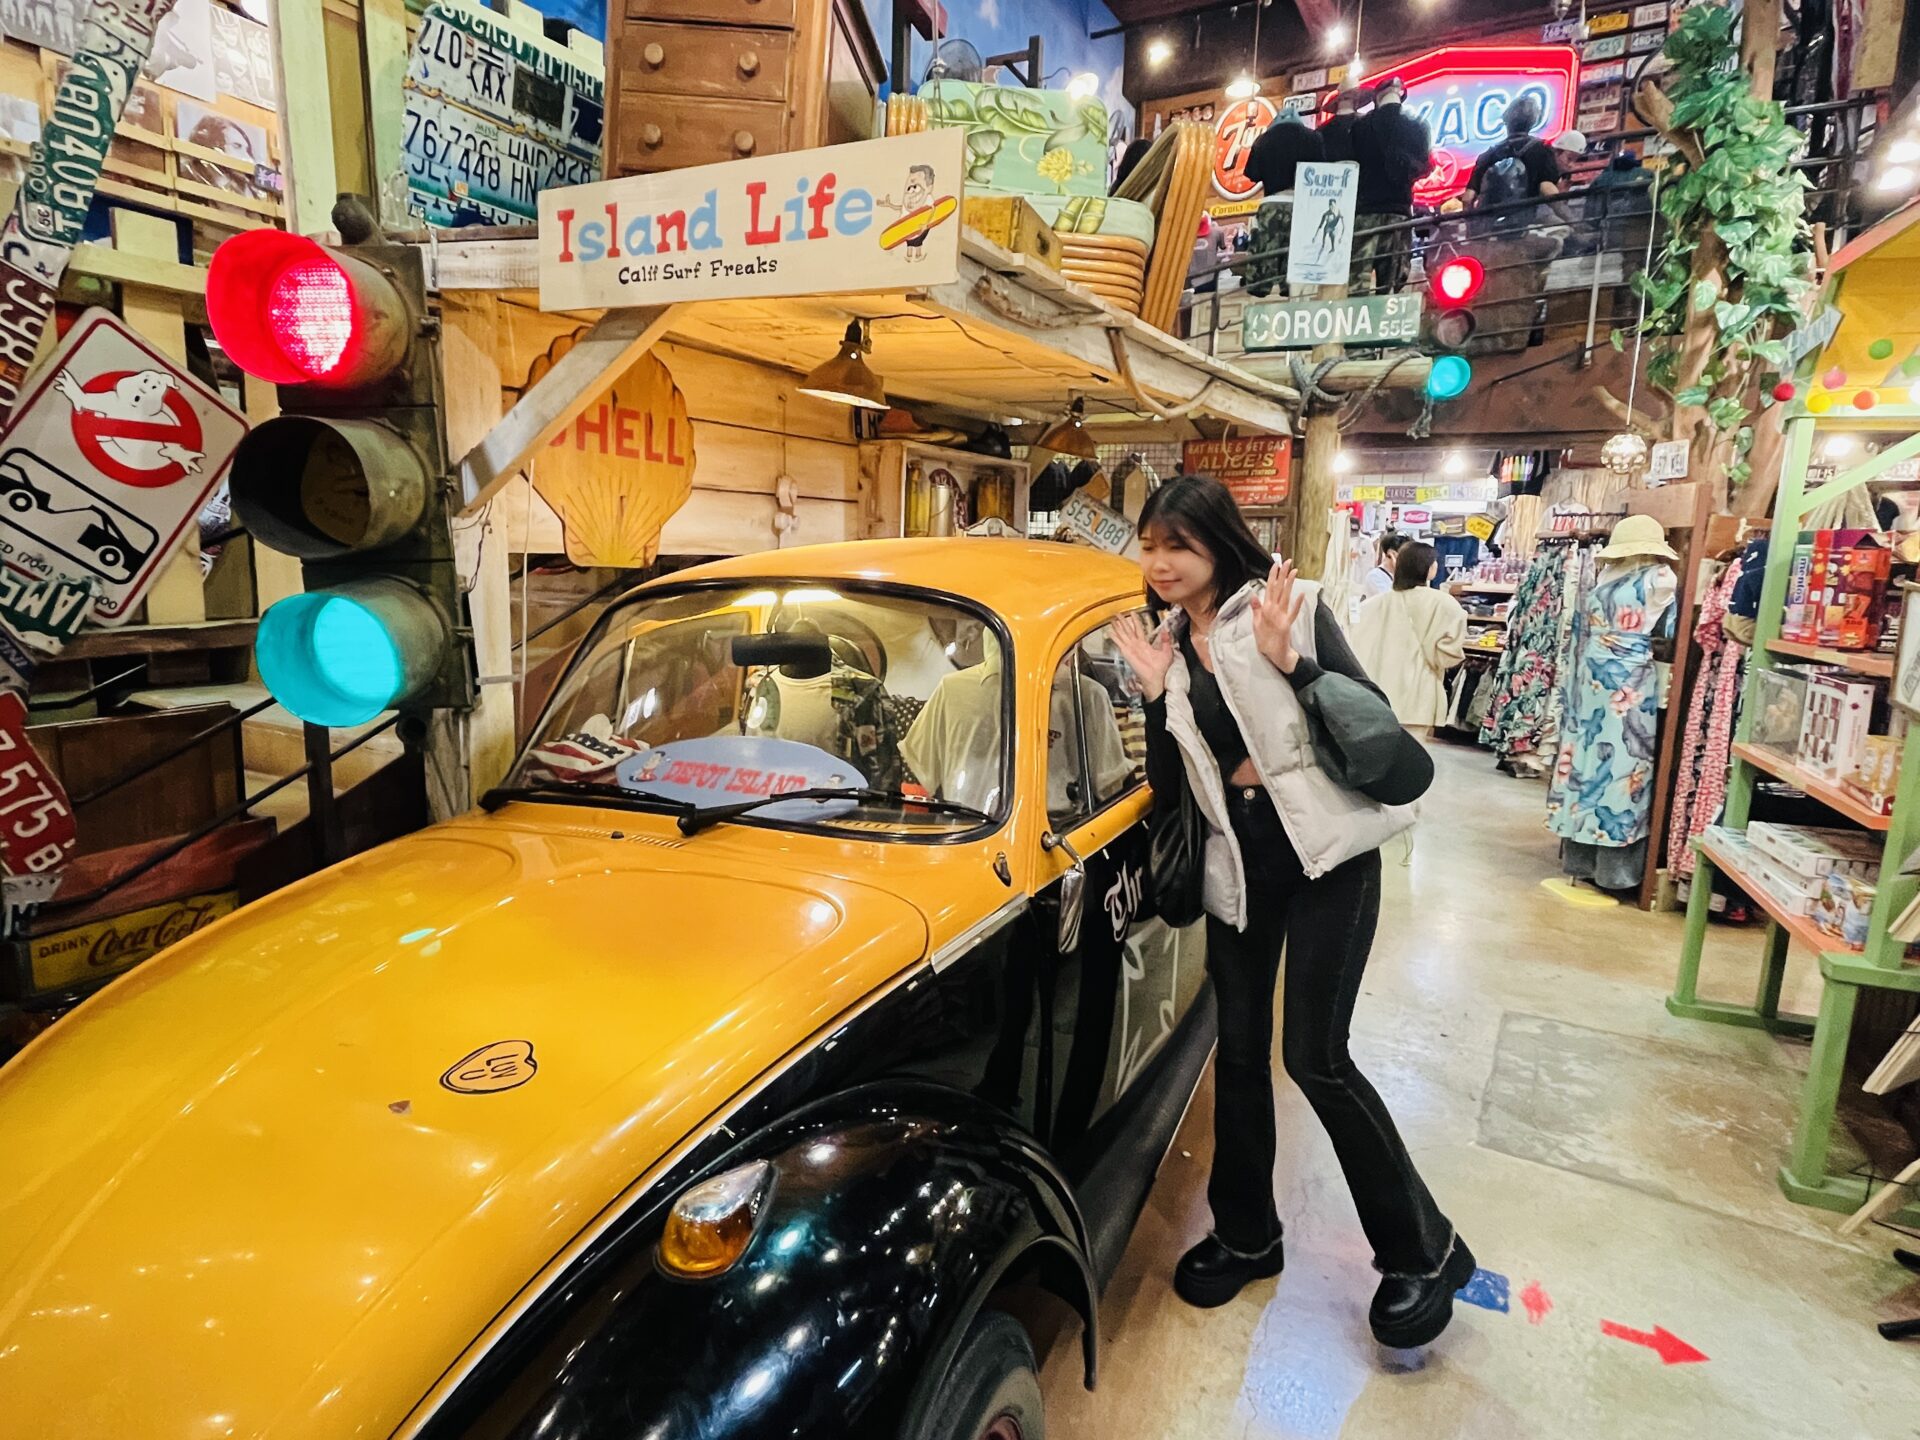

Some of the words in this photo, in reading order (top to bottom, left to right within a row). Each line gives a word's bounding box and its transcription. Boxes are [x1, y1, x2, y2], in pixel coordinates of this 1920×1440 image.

[557, 189, 723, 263] Island
[745, 173, 873, 246] Life
[662, 261, 702, 281] Surf
[710, 256, 778, 278] Freaks
[1252, 305, 1373, 342] CORONA
[1386, 297, 1411, 315] ST
[1198, 453, 1275, 469] ALICE'S
[1267, 439, 1287, 451] GAS
[1794, 556, 1809, 604] mentos
[661, 760, 733, 789] DEPOT
[724, 767, 808, 798] ISLAND
[38, 932, 92, 960] DRINK
